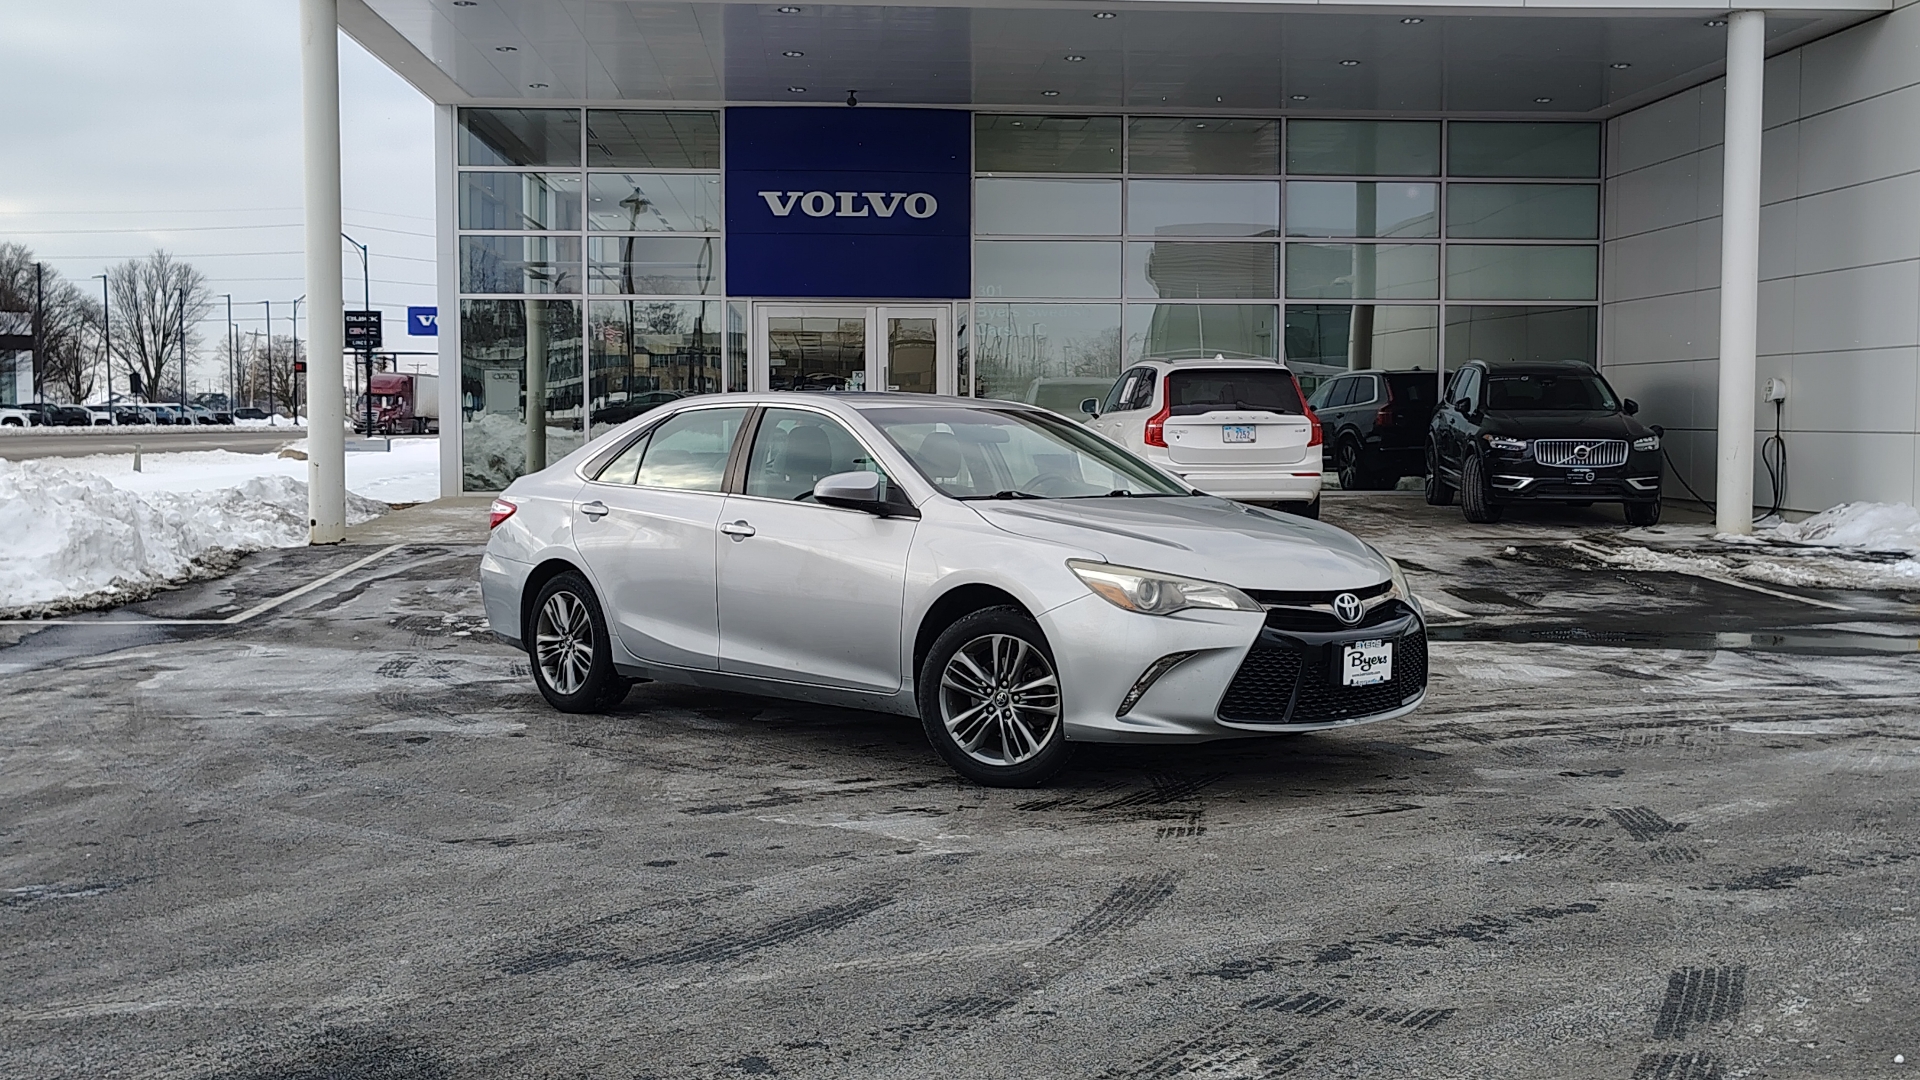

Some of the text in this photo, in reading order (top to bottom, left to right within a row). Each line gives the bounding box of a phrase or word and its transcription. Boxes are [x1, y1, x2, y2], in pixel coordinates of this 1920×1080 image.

[758, 191, 938, 218] VOLVO
[979, 285, 1002, 296] 301
[977, 306, 1019, 320] Byers
[1347, 651, 1387, 672] Byers
